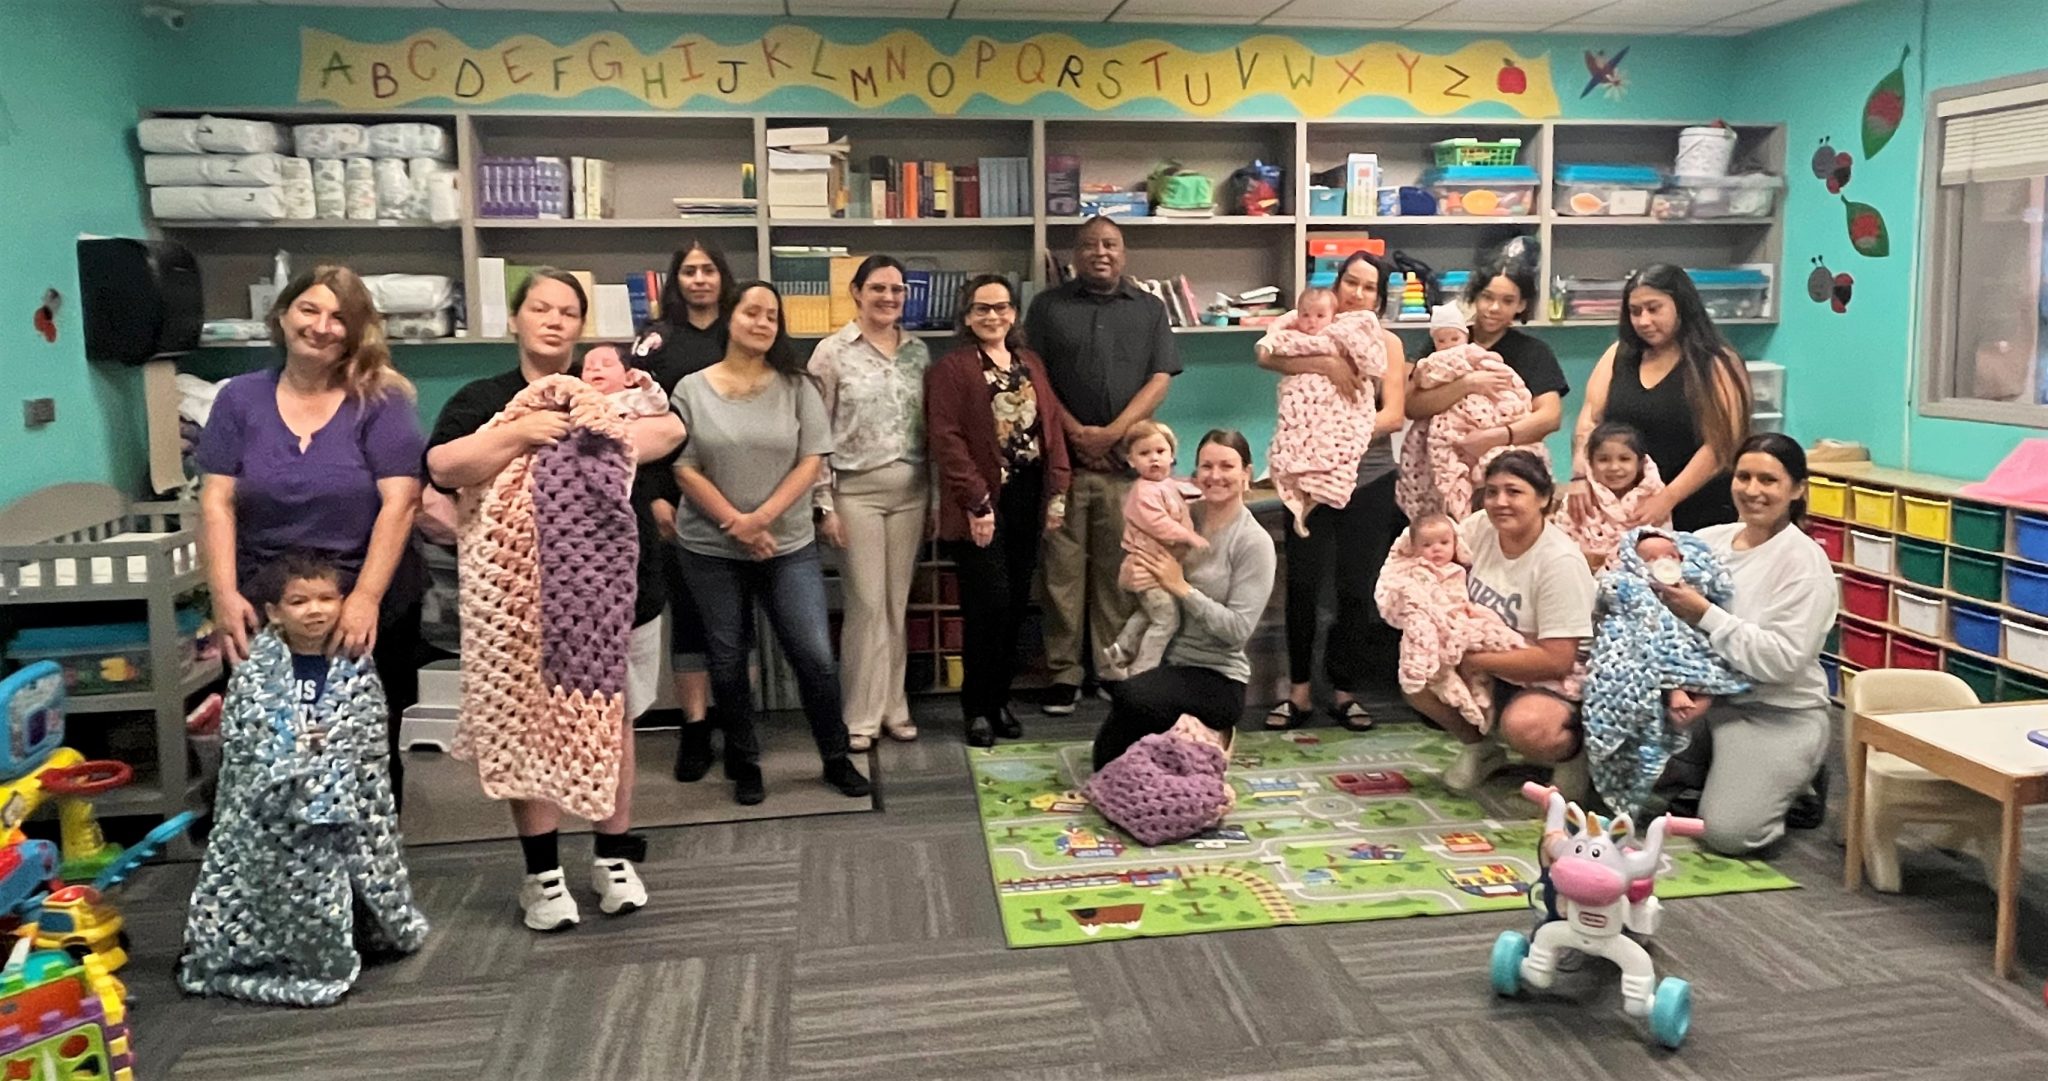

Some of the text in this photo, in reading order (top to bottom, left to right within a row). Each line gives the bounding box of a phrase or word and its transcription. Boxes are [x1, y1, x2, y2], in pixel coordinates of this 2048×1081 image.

[322, 38, 1471, 107] A B C D E F G H I J K L M N O P Q R S T U V W X Y Z
